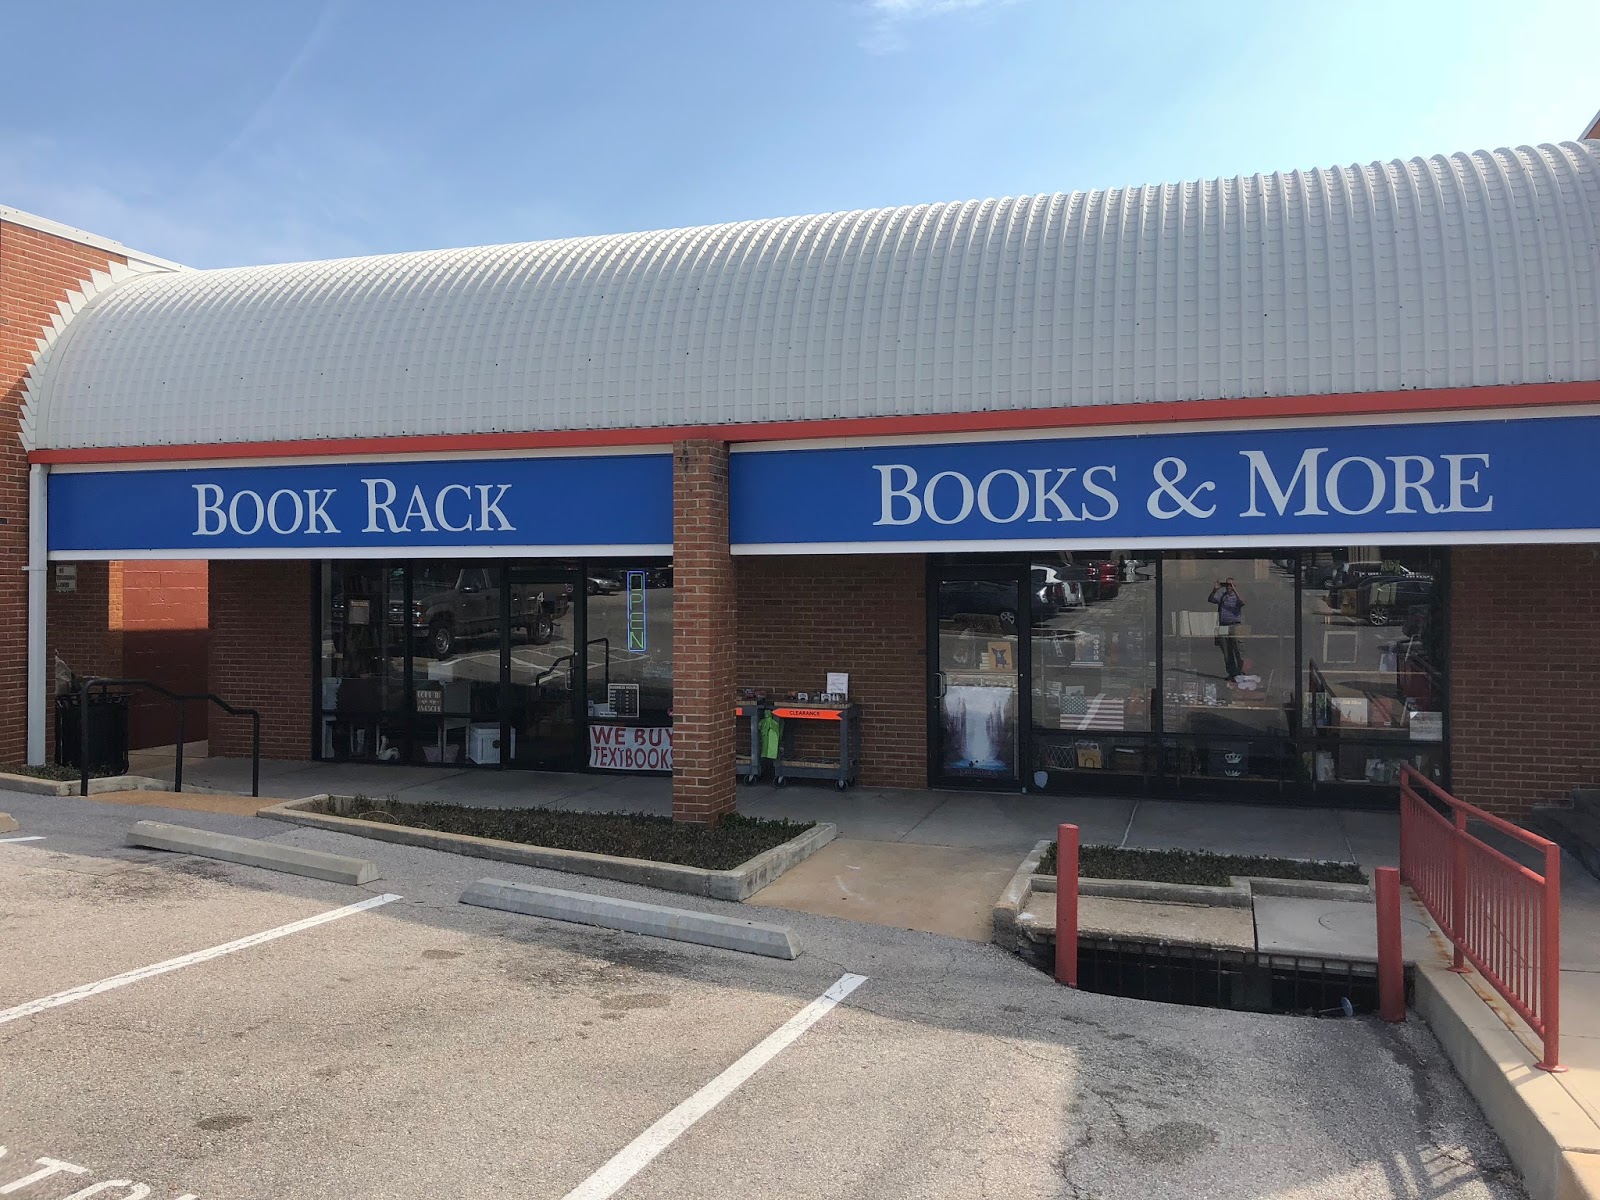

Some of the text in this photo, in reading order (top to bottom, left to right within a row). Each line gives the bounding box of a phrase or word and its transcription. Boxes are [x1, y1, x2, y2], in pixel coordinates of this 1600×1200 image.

[191, 478, 517, 536] BOOK RACK
[872, 447, 1494, 526] BOOKS & MORE
[536, 591, 545, 603] 4
[629, 573, 644, 650] OPEN
[591, 726, 673, 747] WE BUY
[593, 745, 673, 769] TEXTBOOK
